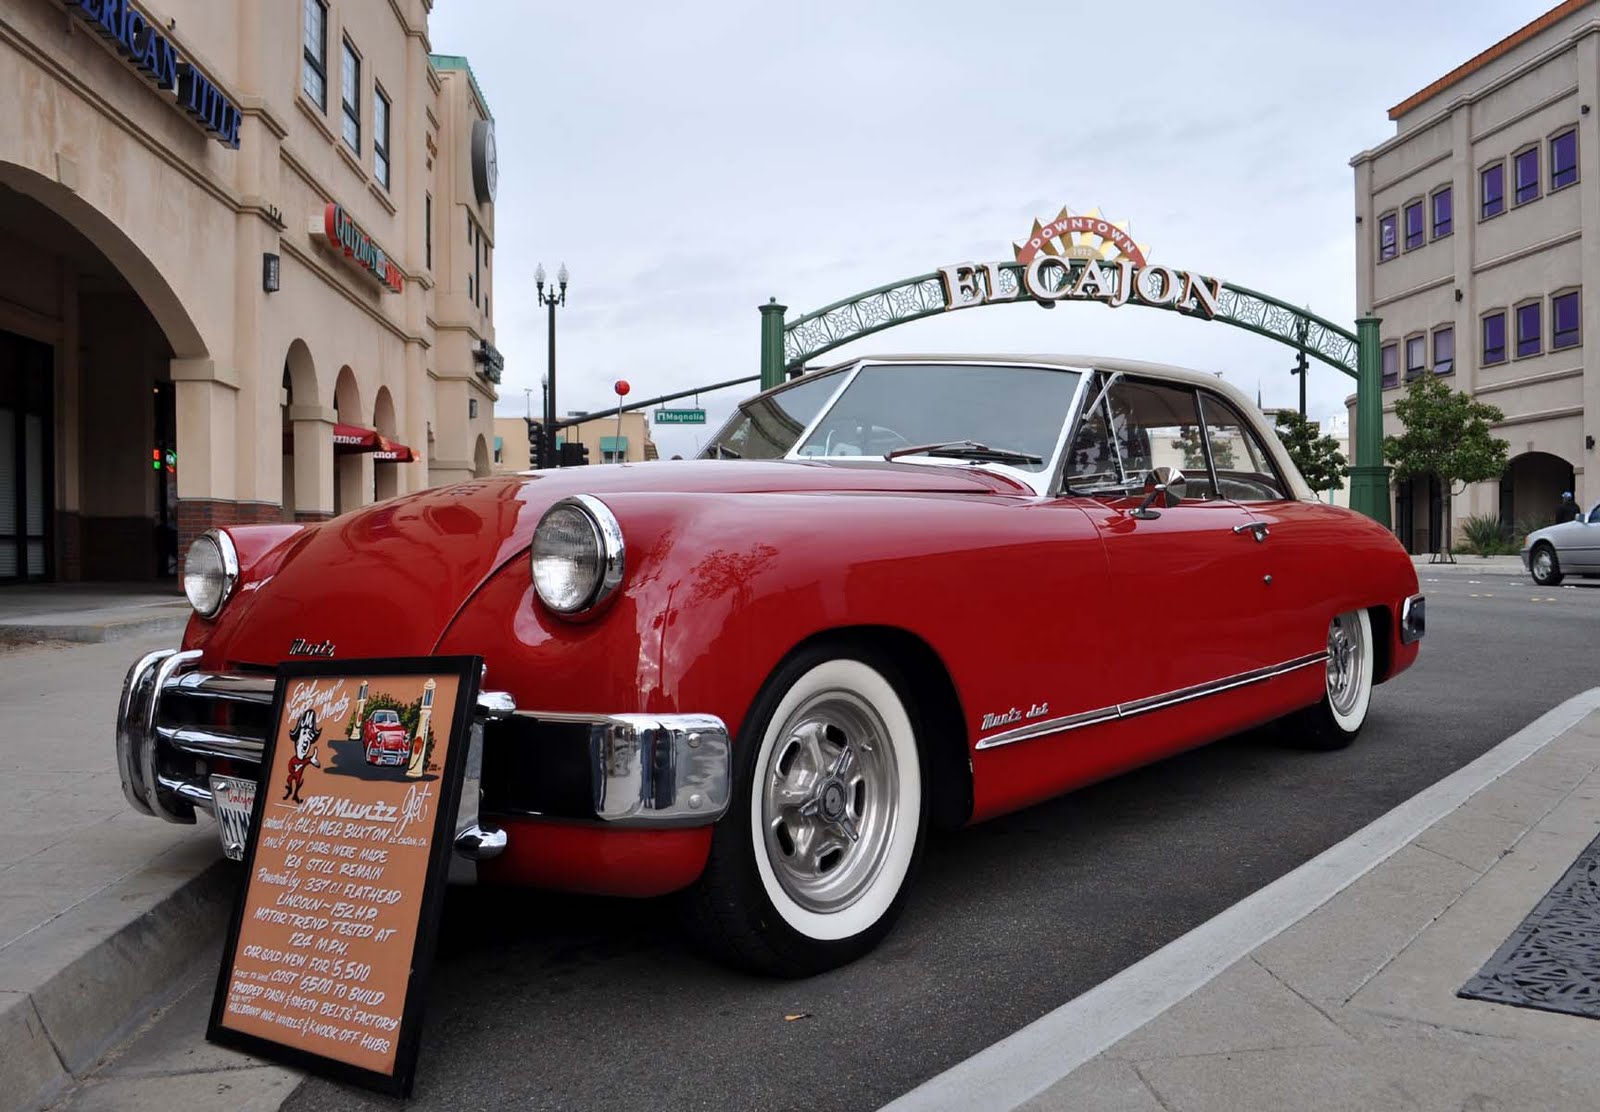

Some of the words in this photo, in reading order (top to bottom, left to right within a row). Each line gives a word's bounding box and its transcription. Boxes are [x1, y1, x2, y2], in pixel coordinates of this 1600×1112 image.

[187, 63, 242, 150] TITLE
[1031, 219, 1135, 253] DOWNTOWN
[938, 261, 1020, 311] EL
[1025, 255, 1226, 321] CAJON
[666, 412, 704, 423] Magnolia
[289, 638, 335, 657] Muntz
[981, 707, 1022, 730] Muntz
[303, 795, 334, 817] 1951
[332, 797, 398, 822] Muntz
[394, 782, 432, 837] Jet
[317, 820, 341, 836] MEG
[343, 823, 391, 842] BUXTON
[263, 837, 284, 849] ONLY
[306, 841, 329, 854] CARS
[332, 844, 357, 859] WERE
[359, 849, 388, 863] MADE
[284, 853, 302, 868] 126
[305, 858, 336, 875] STILL
[339, 863, 384, 881] REMAIN
[256, 868, 288, 885] Powered
[304, 877, 330, 892] 337
[343, 883, 401, 905] FLATHEAD
[276, 892, 322, 911] LINCOLN
[330, 902, 354, 919] 152
[253, 907, 287, 923] MOTOR
[289, 912, 329, 931] TREND
[332, 920, 373, 938] TESTED
[374, 928, 397, 943] AT
[288, 931, 314, 948] 124
[243, 945, 263, 959] CAR
[260, 949, 282, 963] SOLD
[281, 953, 308, 967] NEW
[308, 957, 331, 974] FOR
[232, 981, 264, 996] PADDED
[264, 987, 286, 1004] DASH
[290, 995, 318, 1011] SAFETY
[320, 1002, 353, 1020] BELTS
[271, 969, 299, 985] COST
[333, 984, 349, 999] TO
[348, 987, 385, 1006] BUILD
[275, 1015, 304, 1030] WHEELS
[308, 1019, 340, 1040] KNOCK
[339, 1029, 361, 1044] OFF
[360, 1033, 390, 1054] HUBS
